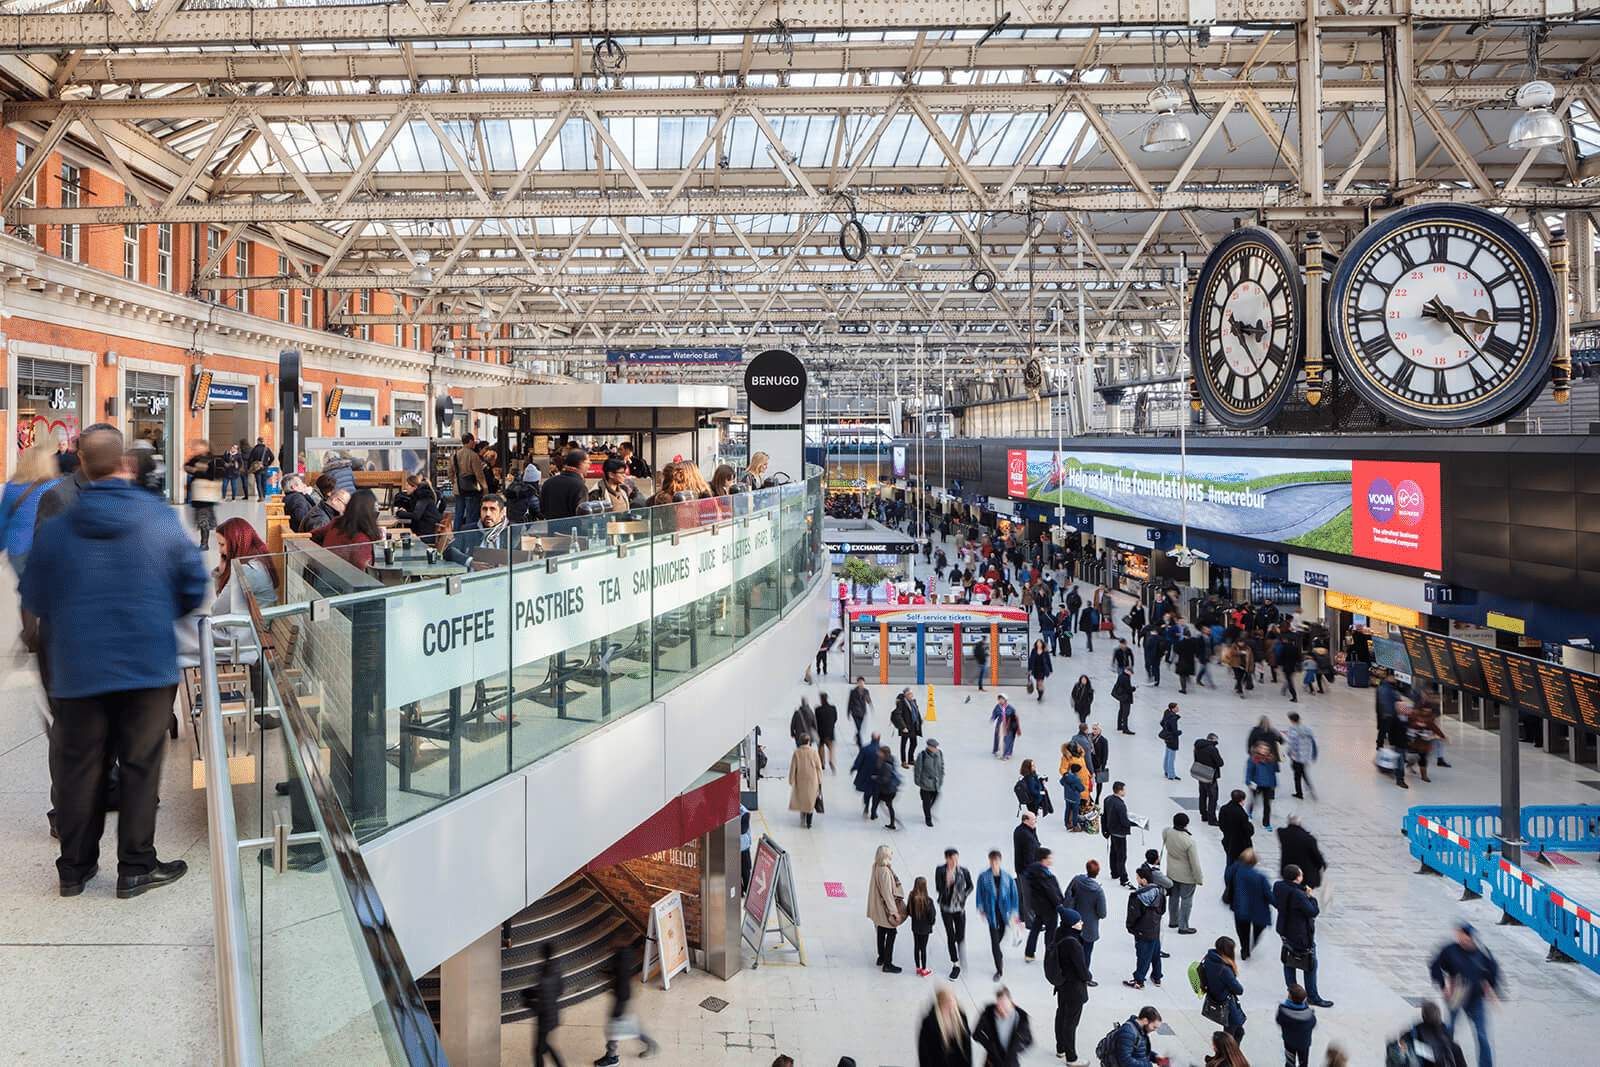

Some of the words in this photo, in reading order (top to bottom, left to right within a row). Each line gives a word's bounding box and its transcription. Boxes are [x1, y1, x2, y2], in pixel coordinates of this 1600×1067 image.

[1411, 272, 1424, 280] 23
[1457, 272, 1468, 280] 13
[1395, 289, 1407, 297] 22
[1473, 289, 1484, 297] 14
[1389, 311, 1400, 319] 21
[1395, 332, 1407, 340] 20
[673, 351, 703, 359] Waterloo
[1411, 348, 1423, 356] 19
[1457, 350, 1469, 358] 17
[1434, 357, 1446, 365] 18
[751, 376, 800, 386] BENUGO
[1068, 466, 1087, 493] Help
[1100, 467, 1115, 497] lay
[1115, 469, 1133, 492] the
[1133, 471, 1204, 501] foundations
[1208, 485, 1266, 509] #macrebur
[1368, 494, 1394, 505] VOOM
[1083, 517, 1089, 525] 8
[1154, 532, 1161, 540] 9
[1268, 553, 1280, 565] 10
[1425, 586, 1435, 600] 11
[1440, 588, 1453, 601] 11
[423, 608, 494, 656] COFFEE
[515, 585, 584, 631] PASTRIES
[599, 577, 621, 605] TEA
[632, 557, 690, 595] SANDWICHES
[698, 548, 716, 573] JUICE
[669, 848, 697, 868] HELLO!
